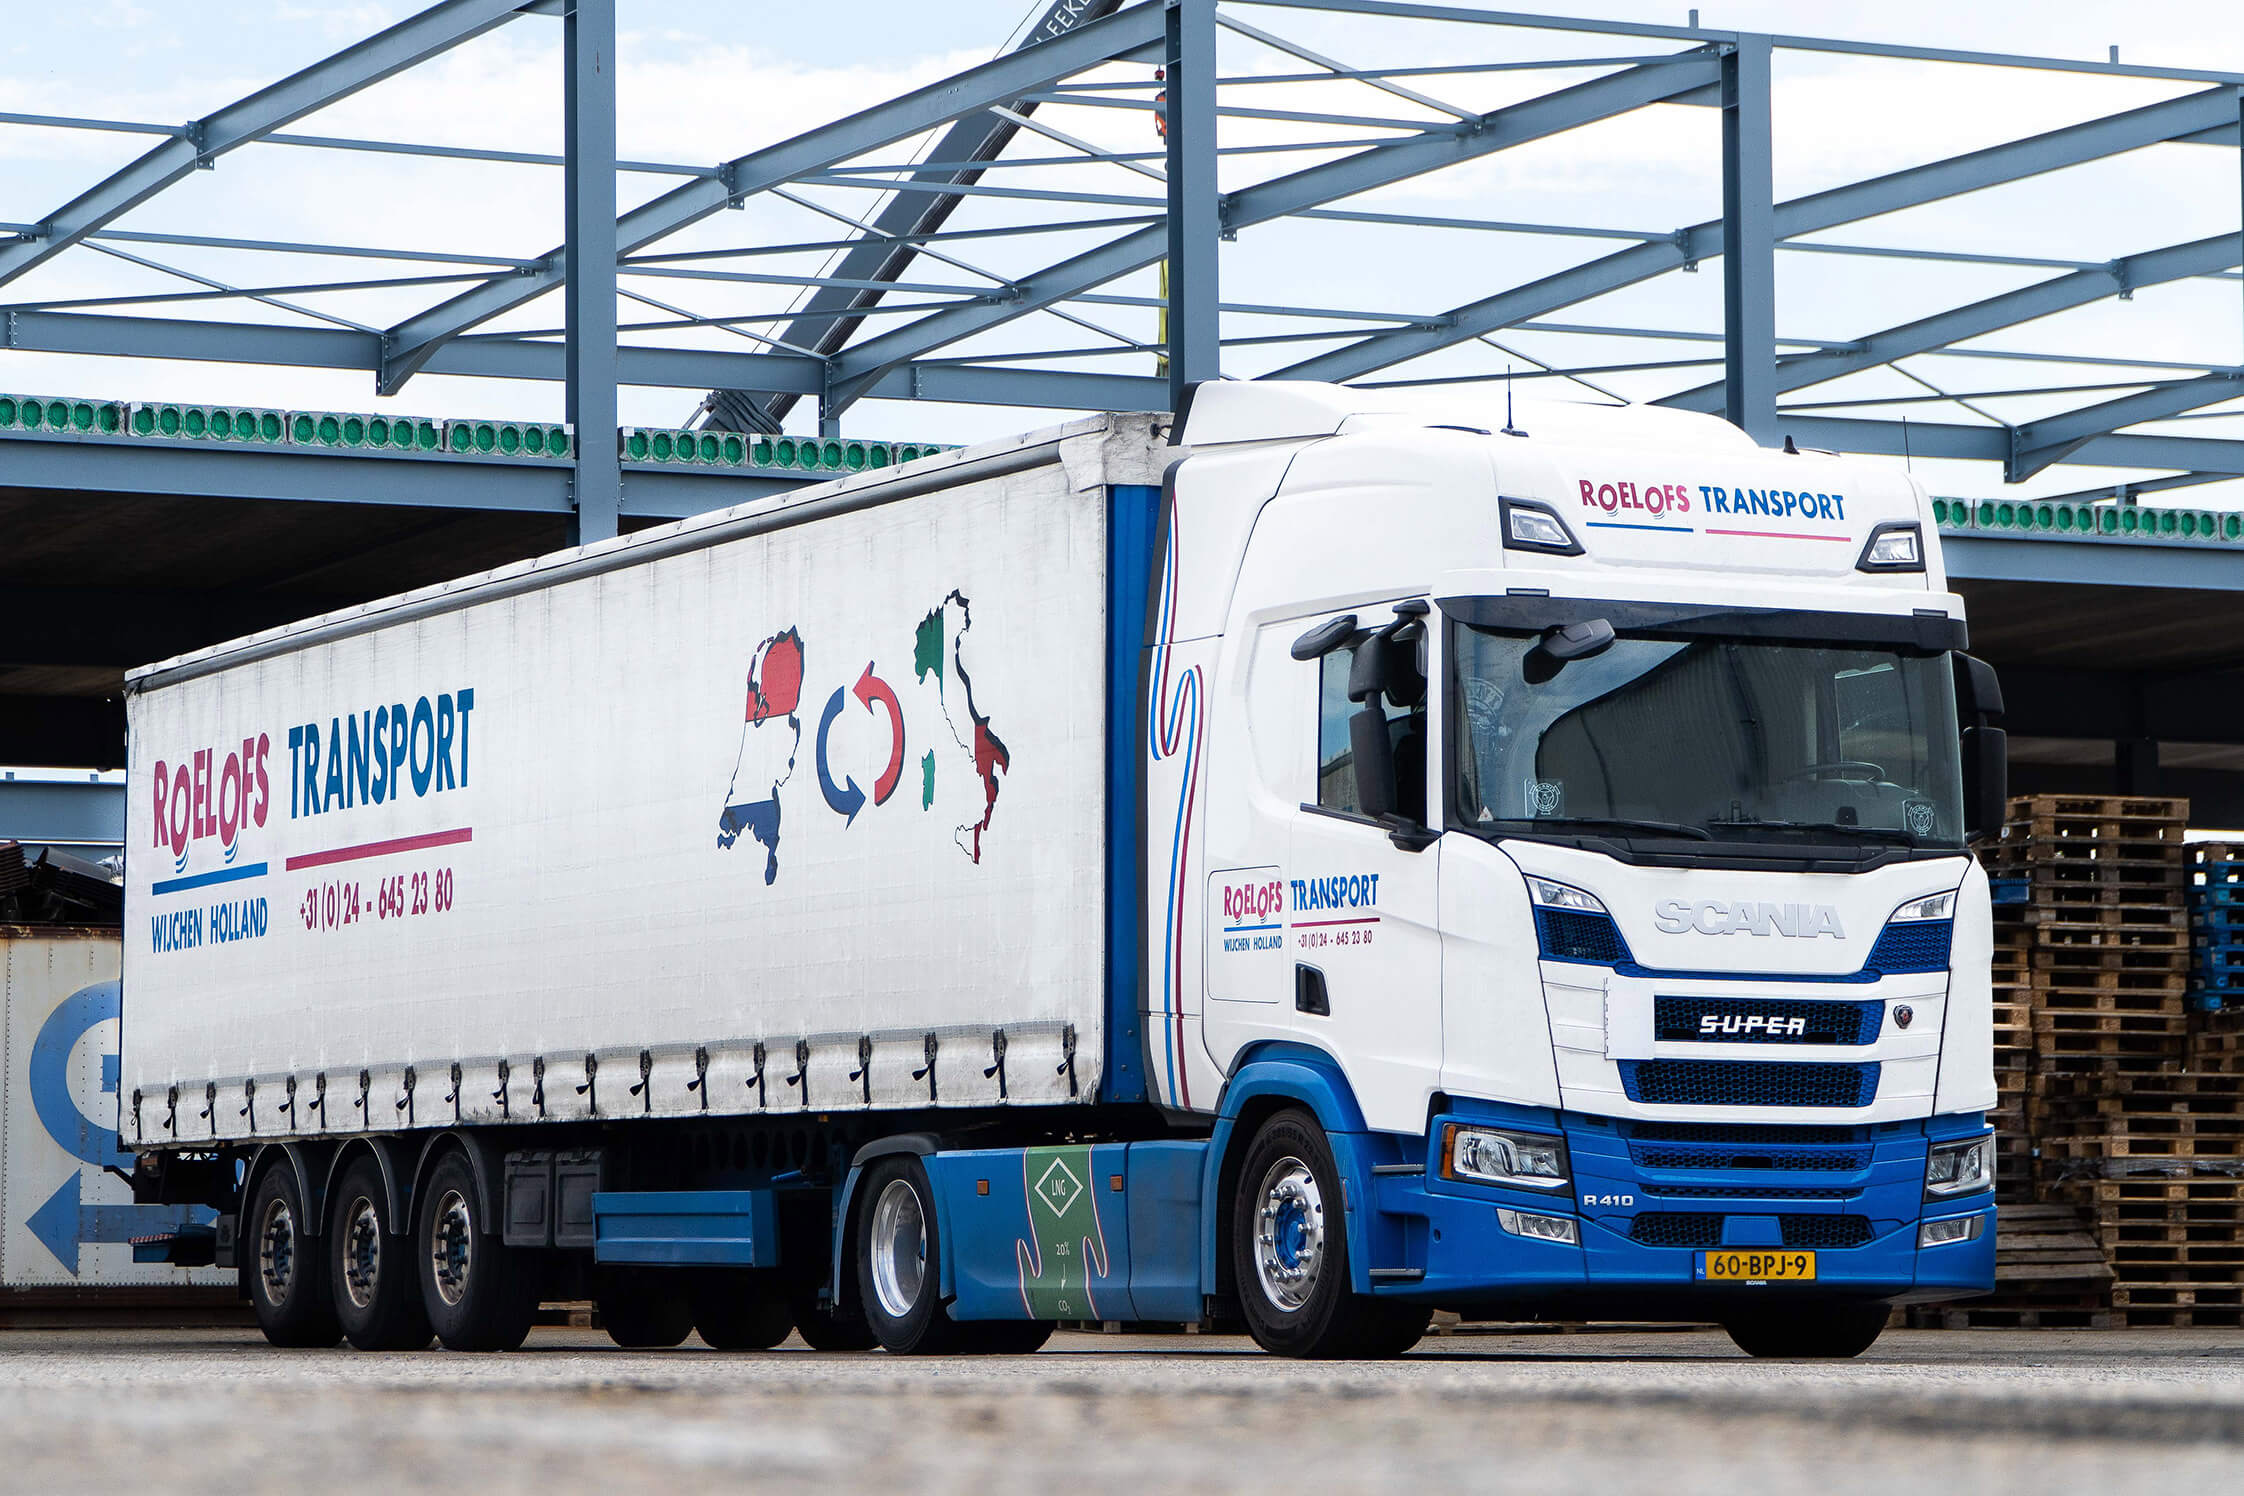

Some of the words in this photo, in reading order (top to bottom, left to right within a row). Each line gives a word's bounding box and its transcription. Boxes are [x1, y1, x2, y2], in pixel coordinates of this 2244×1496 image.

[1036, 0, 1092, 42] EEK
[1579, 479, 1691, 513] ROELOFS
[1699, 486, 1844, 520] TRANSPORT
[153, 732, 270, 858] ROELOFS
[288, 688, 474, 819] TRANSPORT
[378, 875, 404, 920] 645
[411, 871, 428, 915] 23
[435, 867, 453, 913] 80
[1224, 881, 1283, 920] ROELOFS
[1291, 873, 1379, 911] TRANSPORT
[152, 908, 202, 953] WIJCHEN
[210, 897, 268, 945] HOLLAND
[1654, 898, 1846, 939] SCANIA
[1224, 937, 1250, 952] WIJCHEN
[1253, 935, 1282, 950] HOLLAND
[1336, 931, 1349, 945] 645
[1352, 930, 1361, 944] 23
[1363, 929, 1373, 944] 80
[1699, 1015, 1806, 1036] SUPER
[1051, 1179, 1066, 1196] LNG
[1599, 1194, 1634, 1207] 410
[1056, 1241, 1070, 1256] 20%
[1713, 1255, 1807, 1276] 60-BPJ-9
